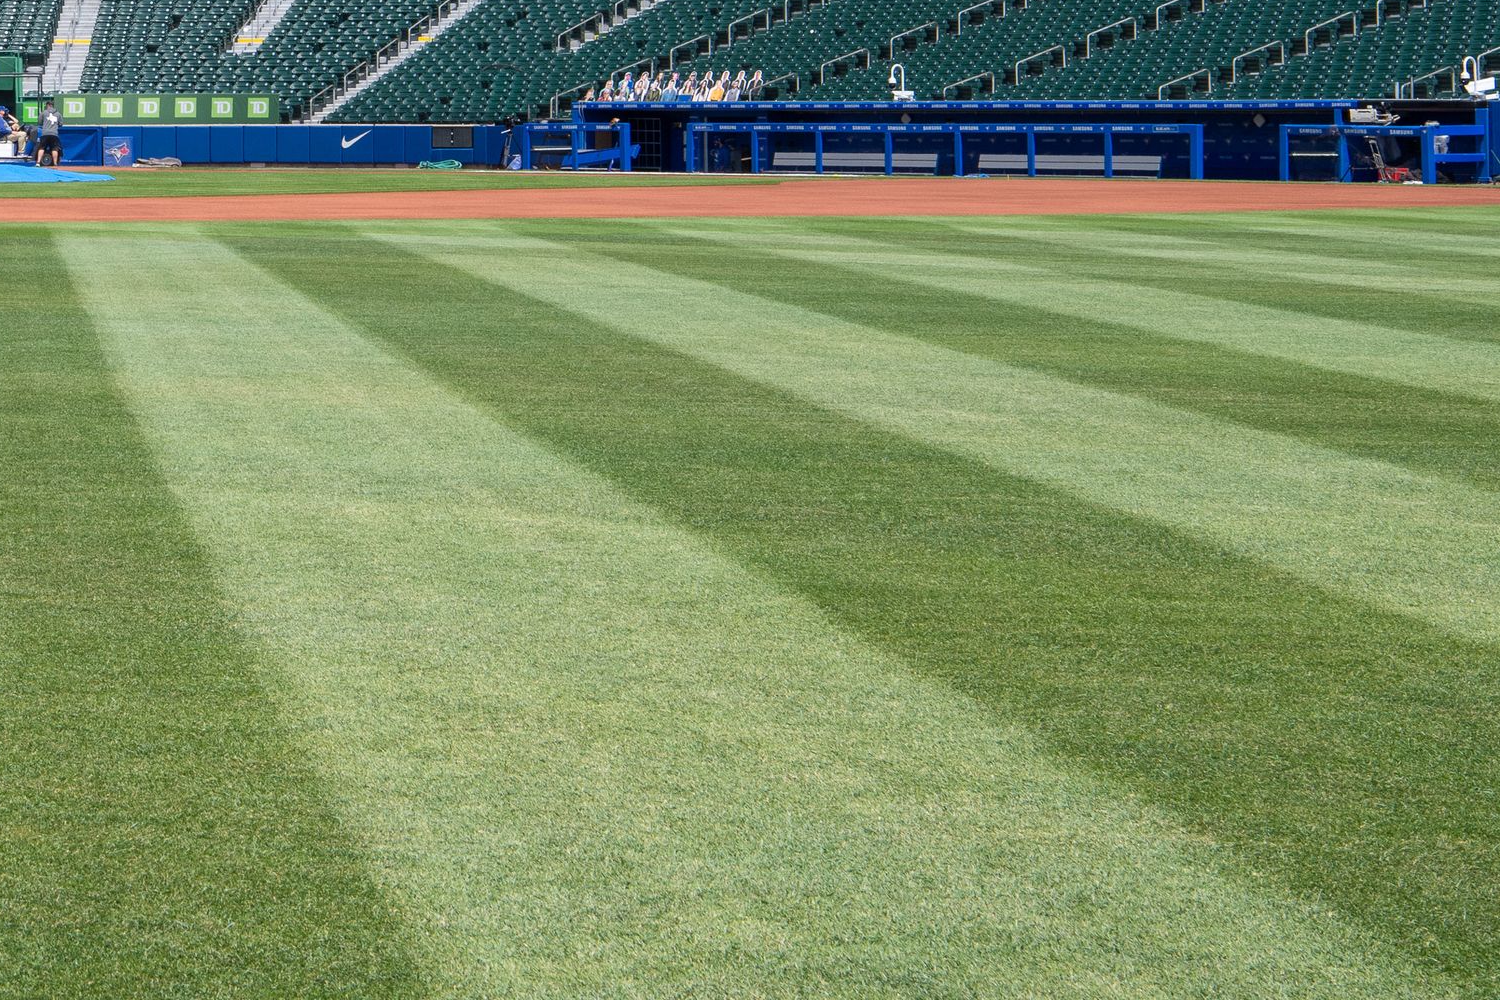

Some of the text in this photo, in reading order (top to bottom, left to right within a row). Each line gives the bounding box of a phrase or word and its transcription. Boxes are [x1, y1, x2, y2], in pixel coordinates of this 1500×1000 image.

[66, 101, 267, 114] TD TD TD TD TD TD
